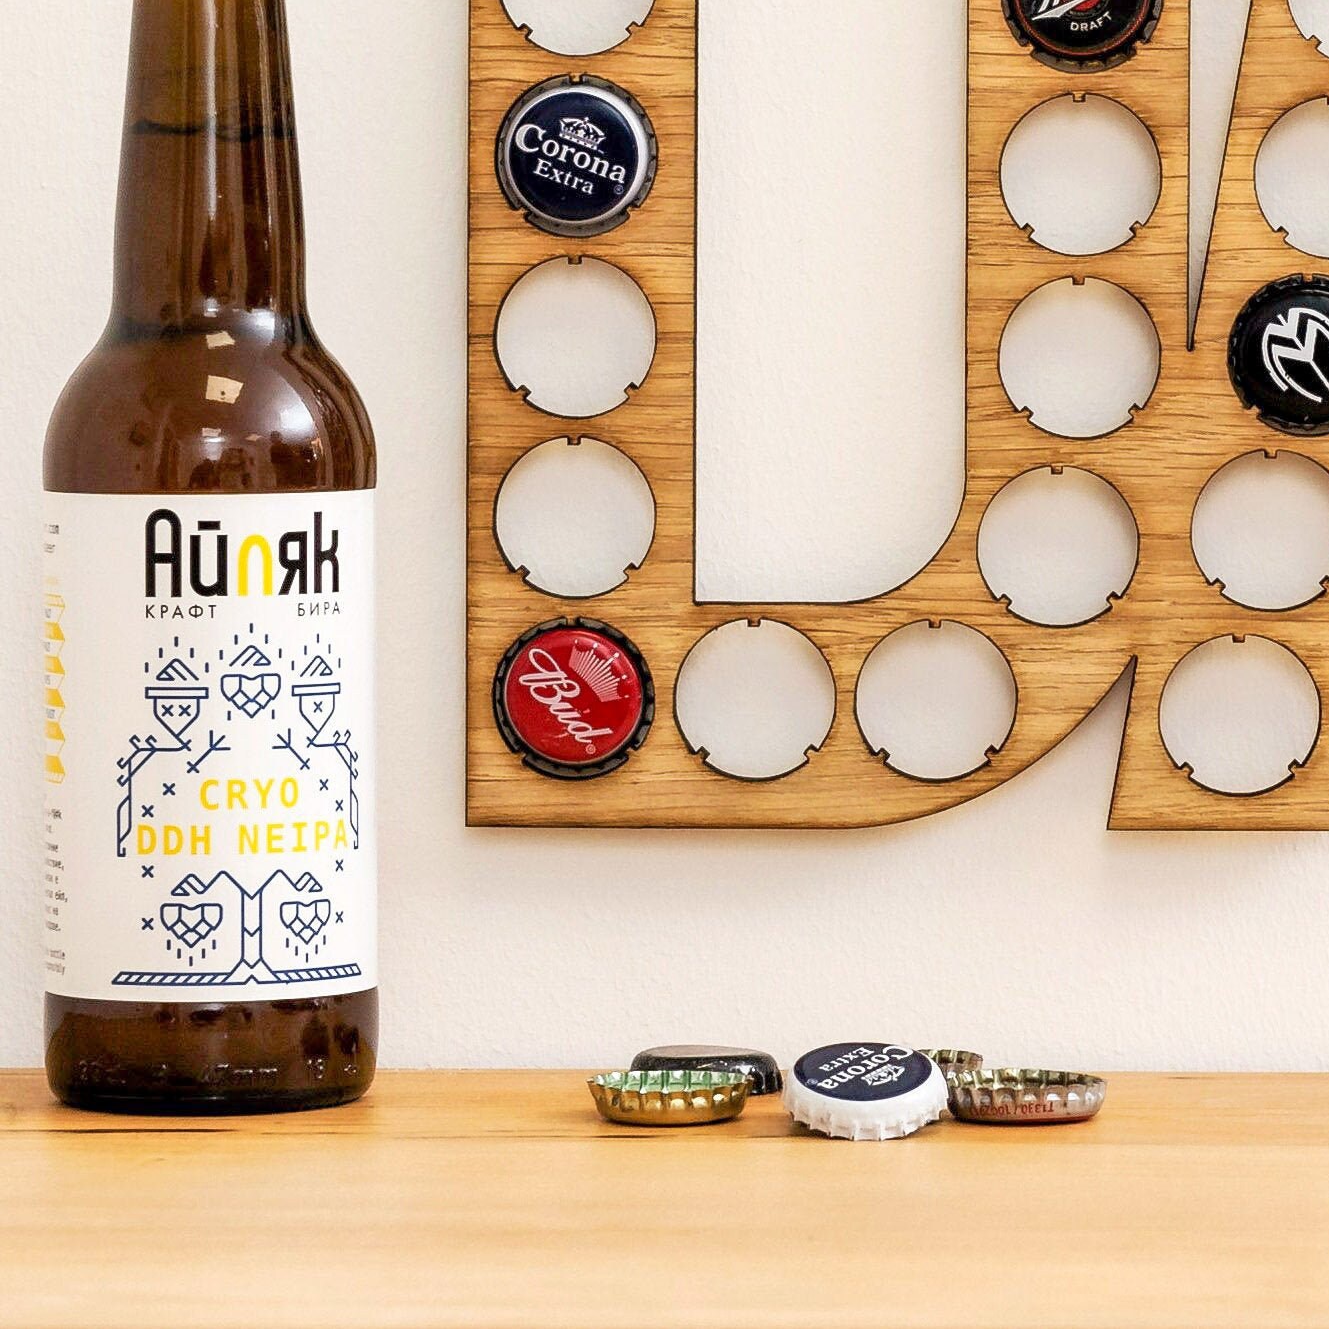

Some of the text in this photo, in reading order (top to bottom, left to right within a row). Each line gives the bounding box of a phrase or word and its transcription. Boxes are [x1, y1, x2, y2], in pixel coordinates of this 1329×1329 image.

[1070, 11, 1112, 31] DRAFT
[515, 123, 626, 183] Corona
[533, 158, 595, 195] Extra
[145, 601, 341, 619] КРАФТ БИРА
[518, 648, 614, 744] Bud
[199, 777, 299, 811] CRYO
[137, 819, 348, 856] DDH NEIPA
[816, 1045, 914, 1089] Corona
[819, 1046, 875, 1072] Extra
